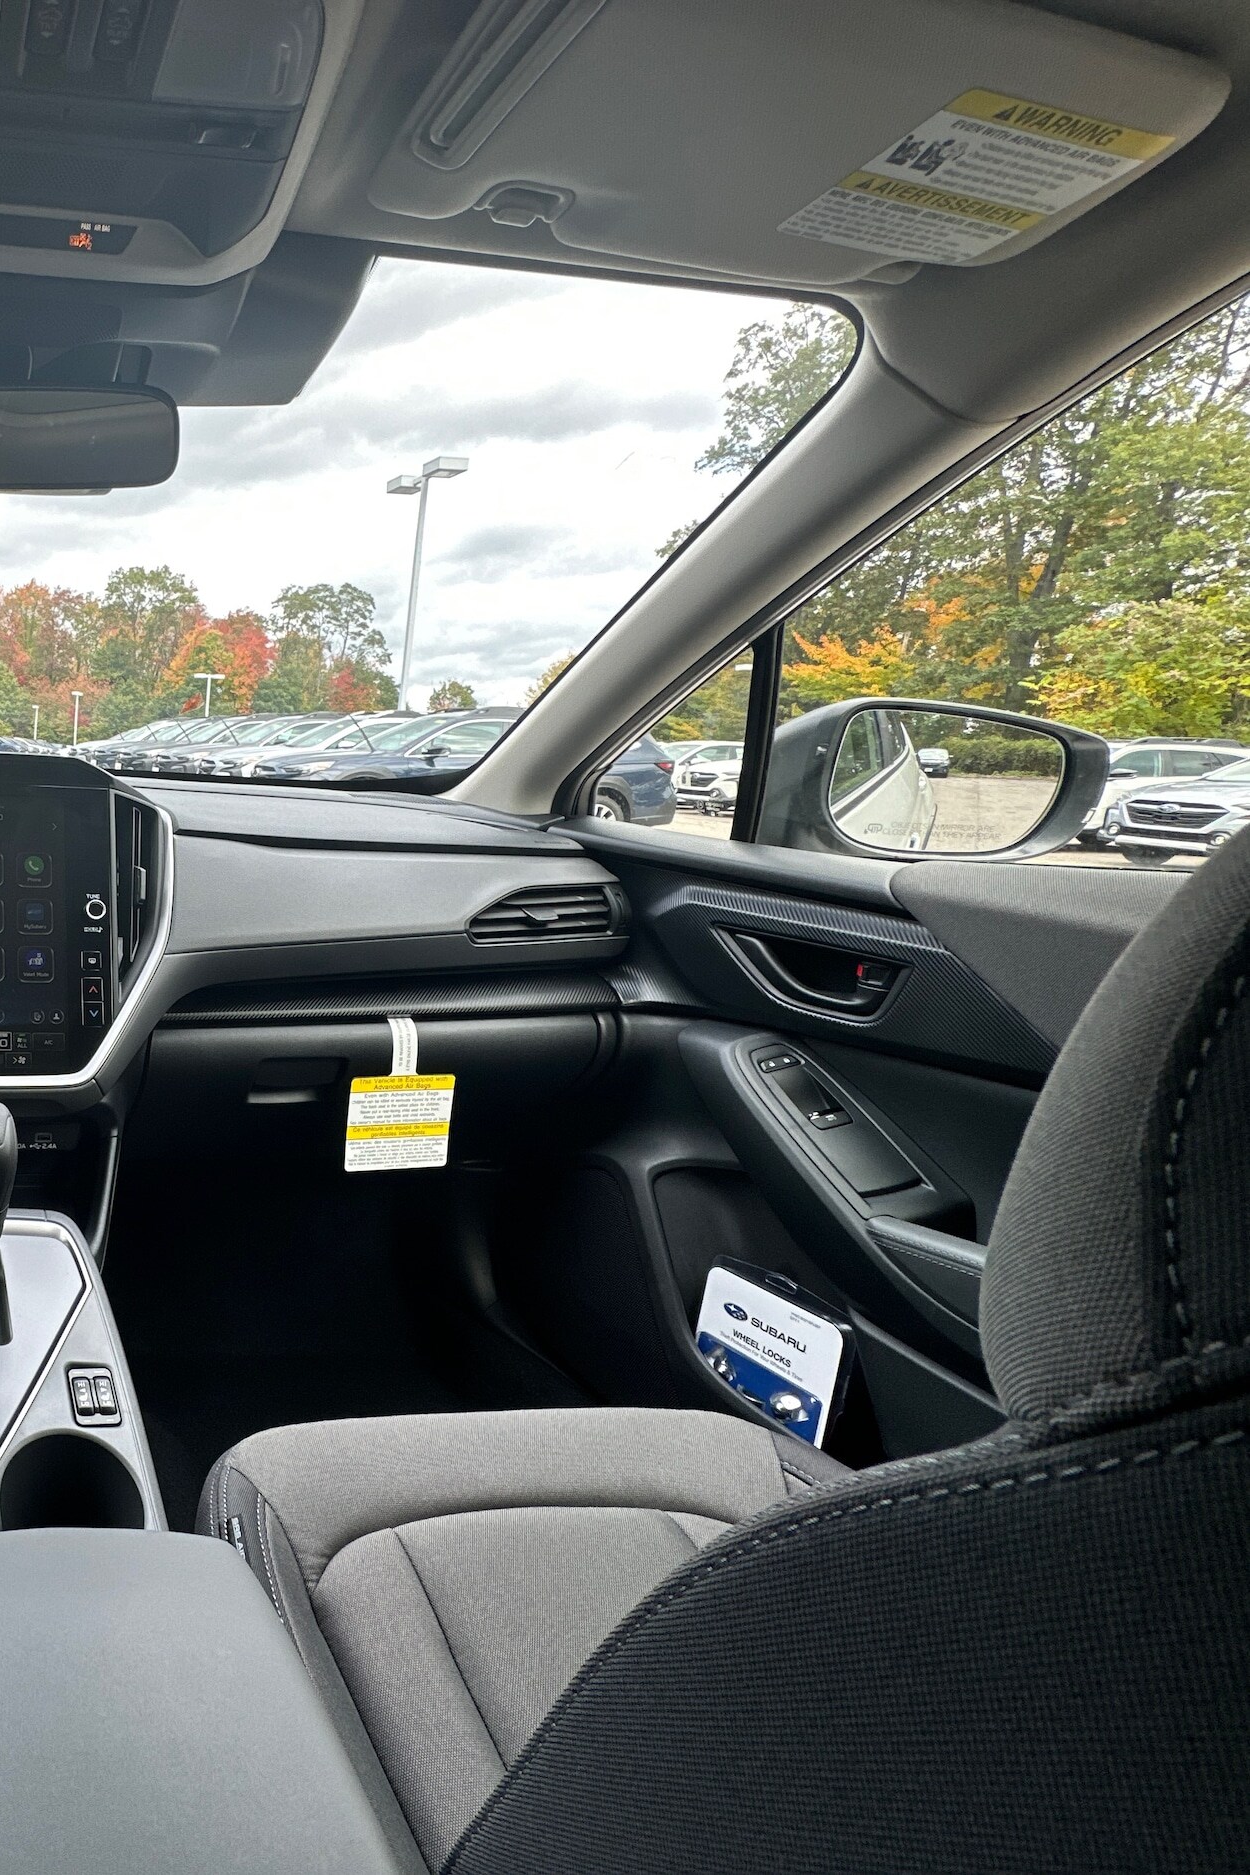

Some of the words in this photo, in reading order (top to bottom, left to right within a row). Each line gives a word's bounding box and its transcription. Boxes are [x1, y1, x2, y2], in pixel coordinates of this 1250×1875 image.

[1014, 106, 1123, 147] WARNING
[875, 181, 1031, 224] AVERTISSEMENT
[80, 222, 92, 230] PASS
[102, 224, 110, 232] BAG
[732, 1328, 760, 1350] WHEEL
[762, 1346, 792, 1368] LOCKS
[750, 1317, 807, 1353] SUBARU
